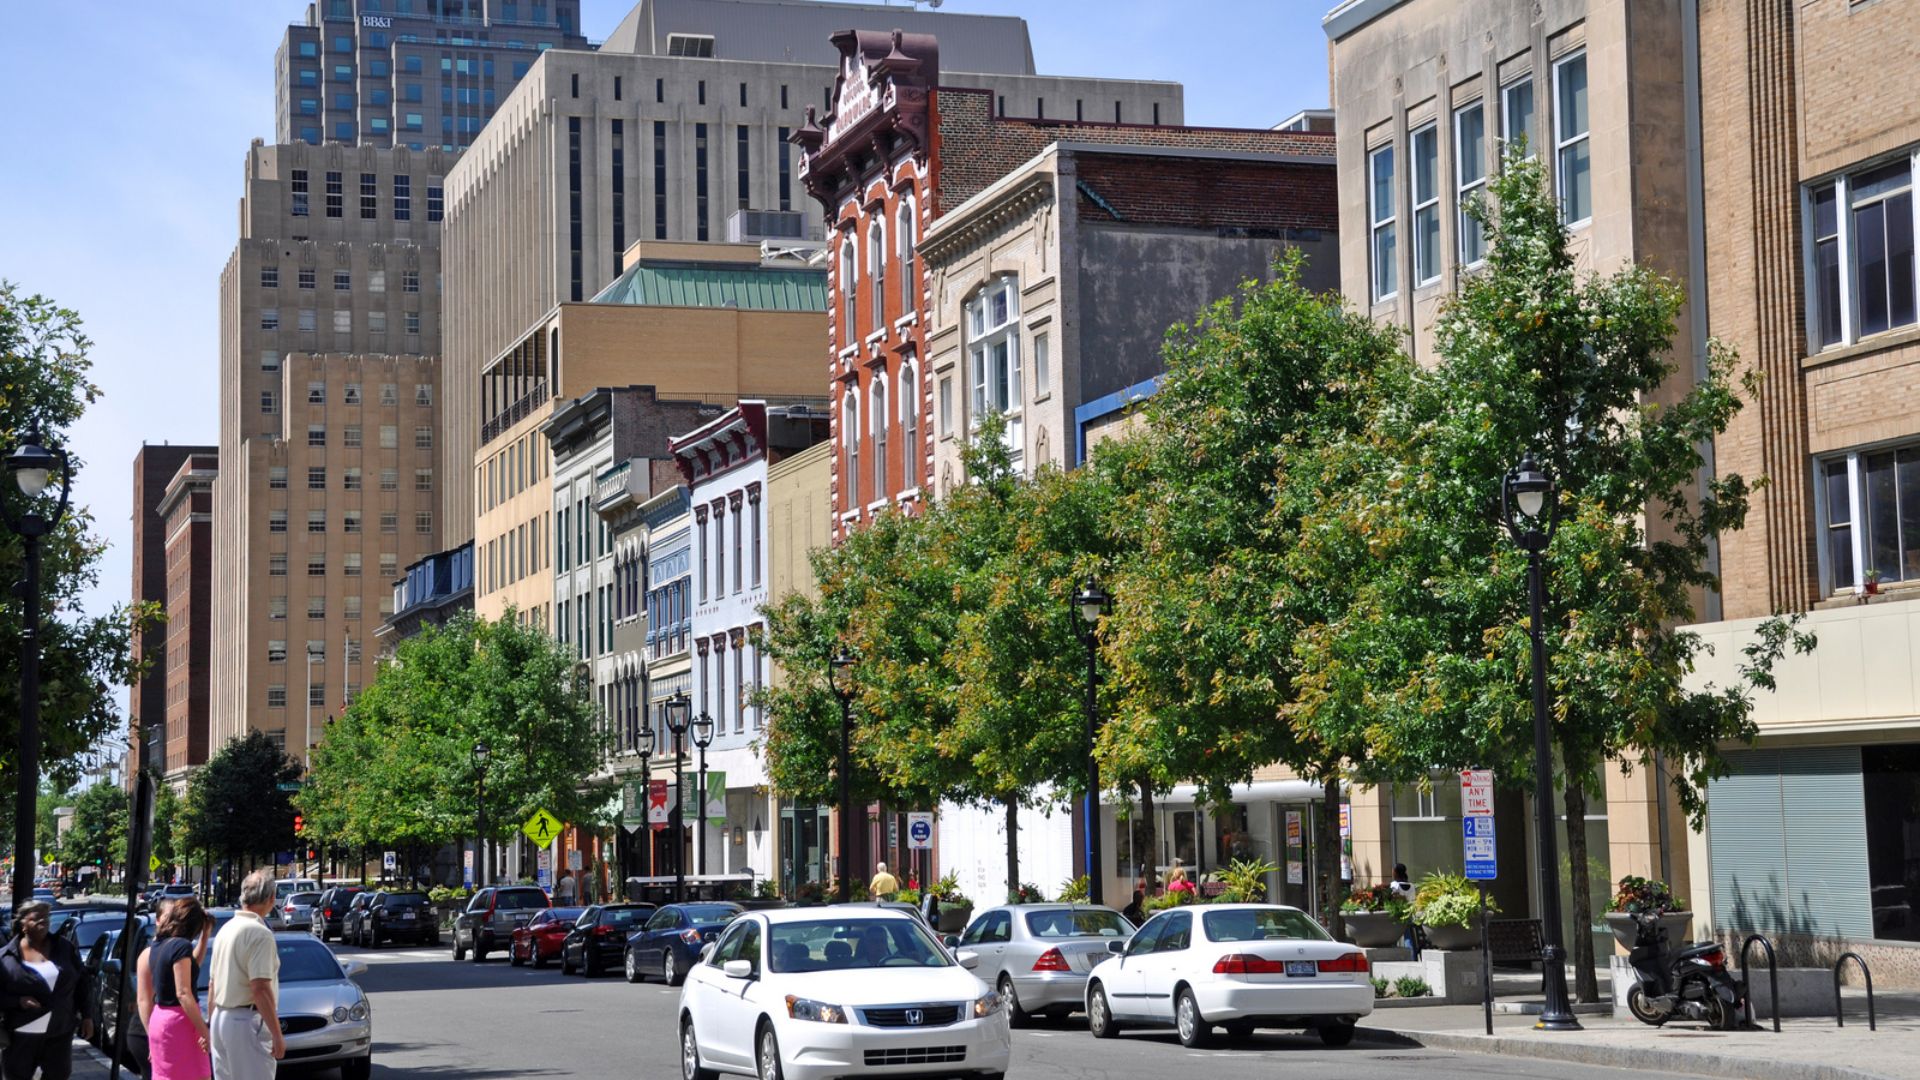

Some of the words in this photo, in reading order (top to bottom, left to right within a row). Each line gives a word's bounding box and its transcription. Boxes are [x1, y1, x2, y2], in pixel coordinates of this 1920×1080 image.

[362, 16, 391, 28] BB&T
[1468, 787, 1485, 796] ANY
[1468, 798, 1487, 808] TIME
[1466, 820, 1473, 835] 2
